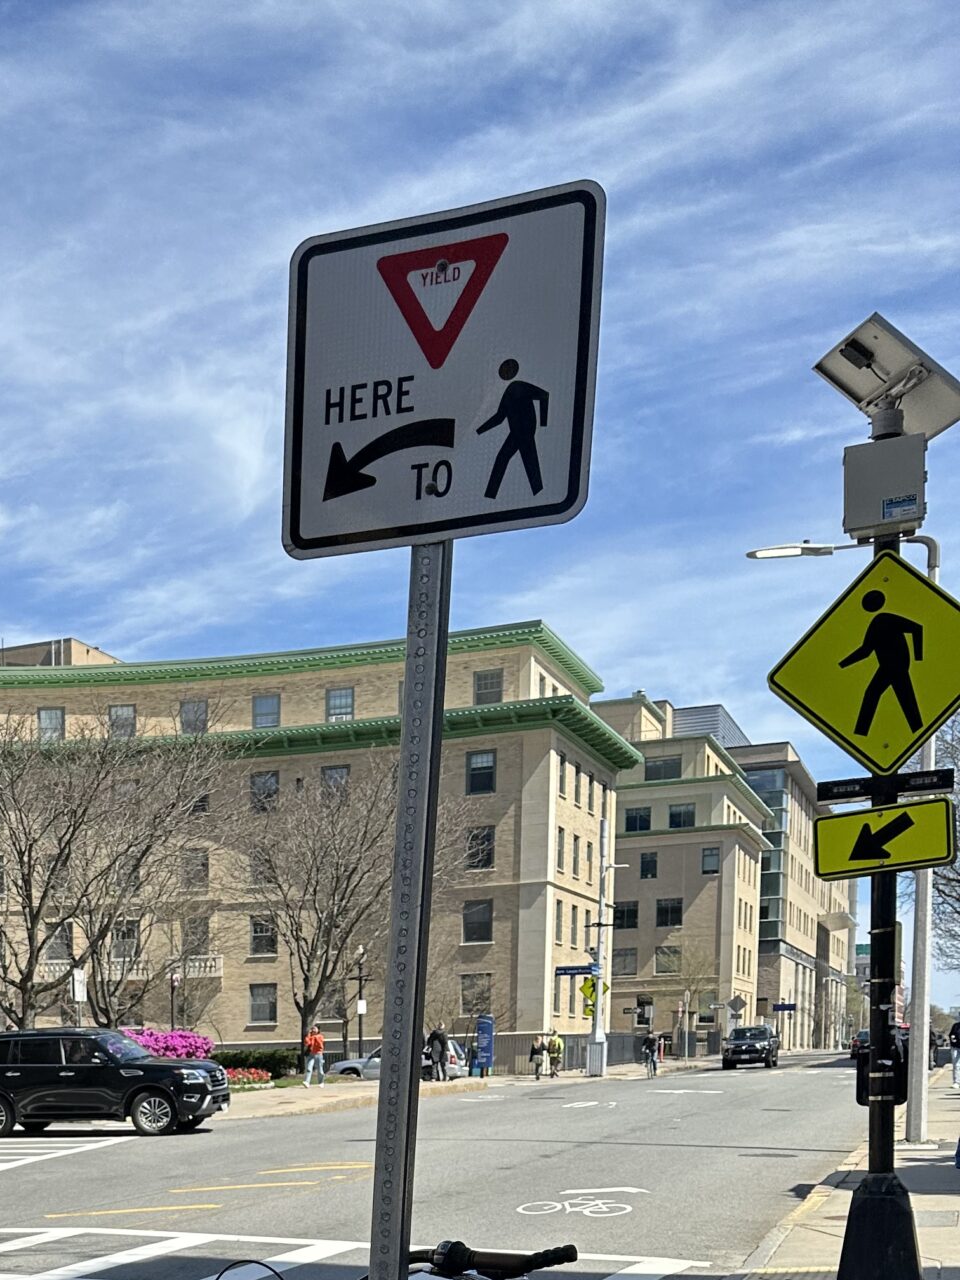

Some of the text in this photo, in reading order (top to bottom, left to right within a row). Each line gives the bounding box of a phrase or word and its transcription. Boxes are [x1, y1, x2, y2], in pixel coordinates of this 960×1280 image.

[421, 266, 461, 287] YIELD
[324, 375, 415, 425] HERE
[411, 459, 453, 501] TO
